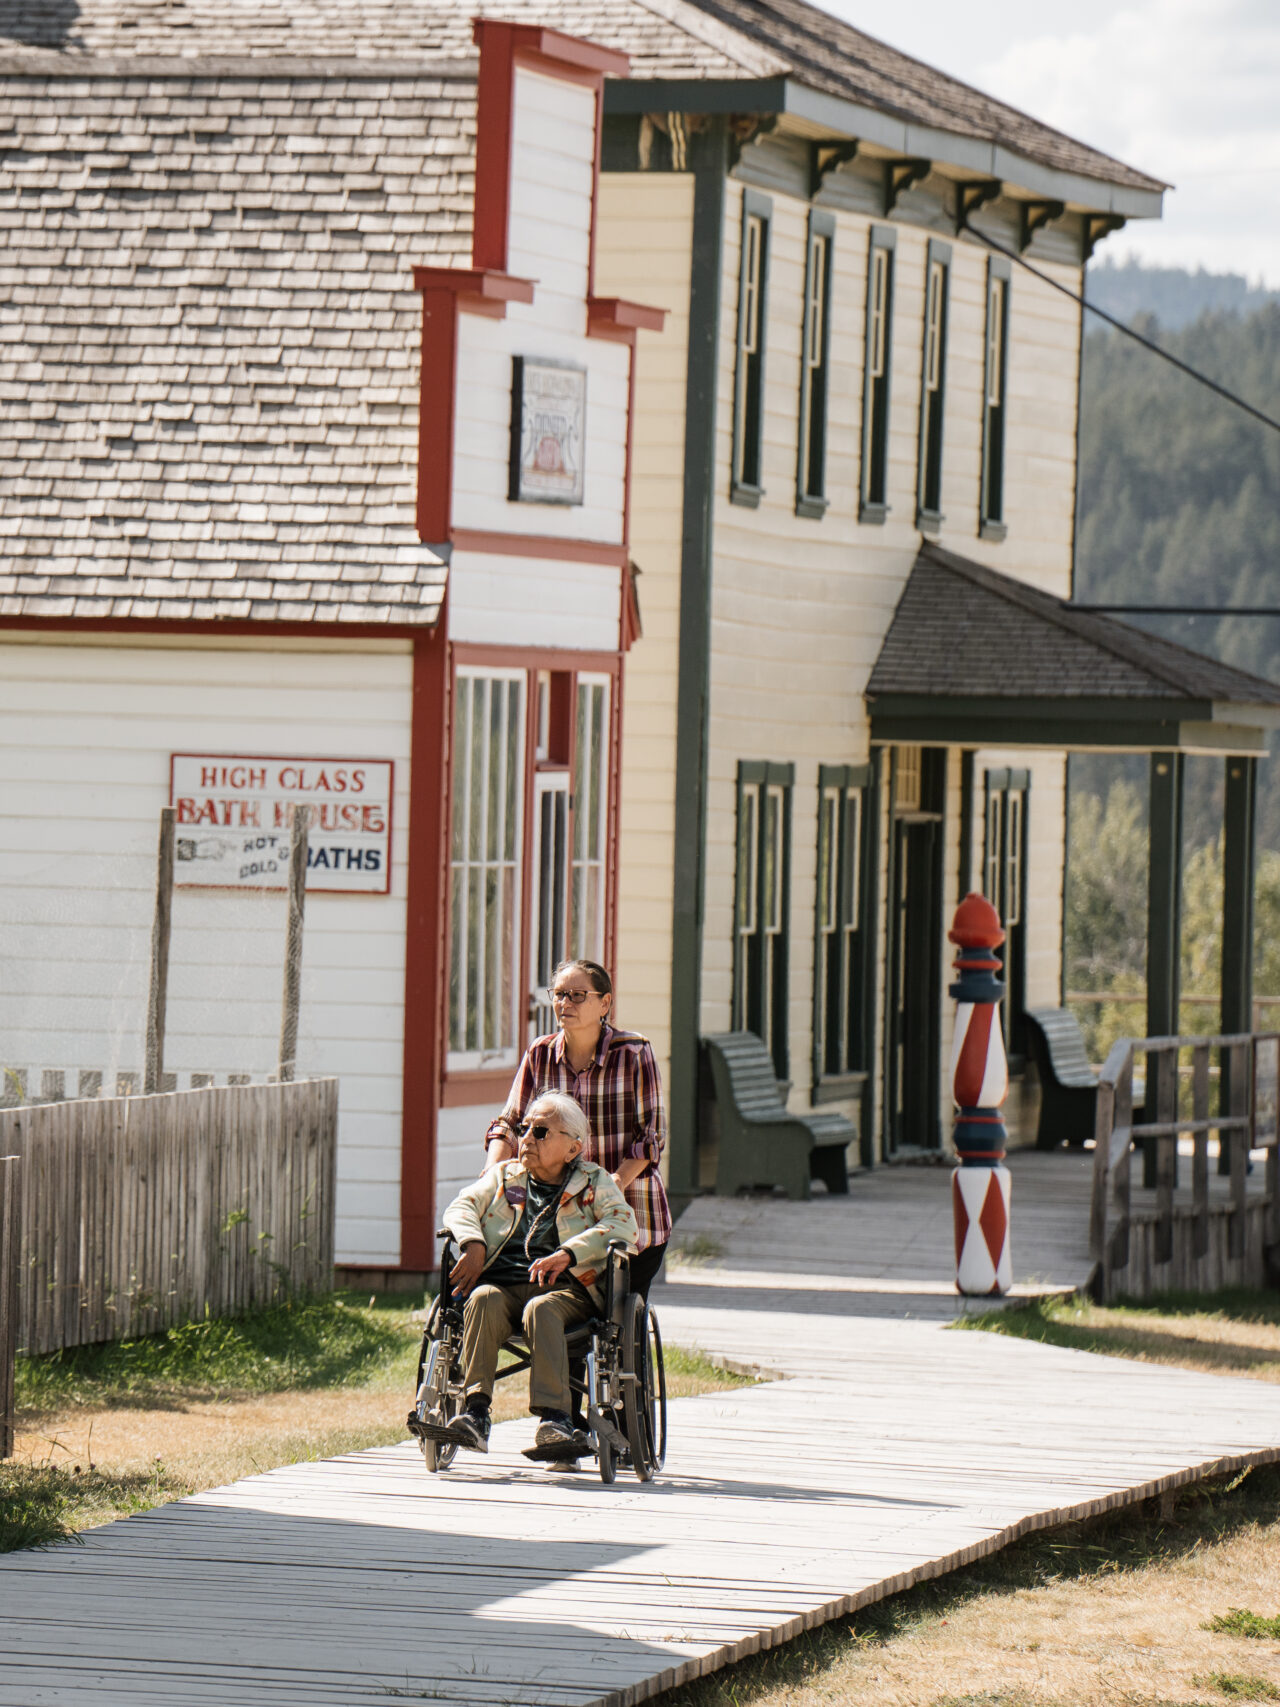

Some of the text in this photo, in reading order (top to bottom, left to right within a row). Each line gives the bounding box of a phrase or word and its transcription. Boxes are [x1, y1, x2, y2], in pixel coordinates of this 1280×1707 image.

[200, 766, 366, 793] HIGH CLASS
[176, 798, 261, 828] BATH
[242, 836, 279, 853] HOT
[239, 860, 278, 879] COLD
